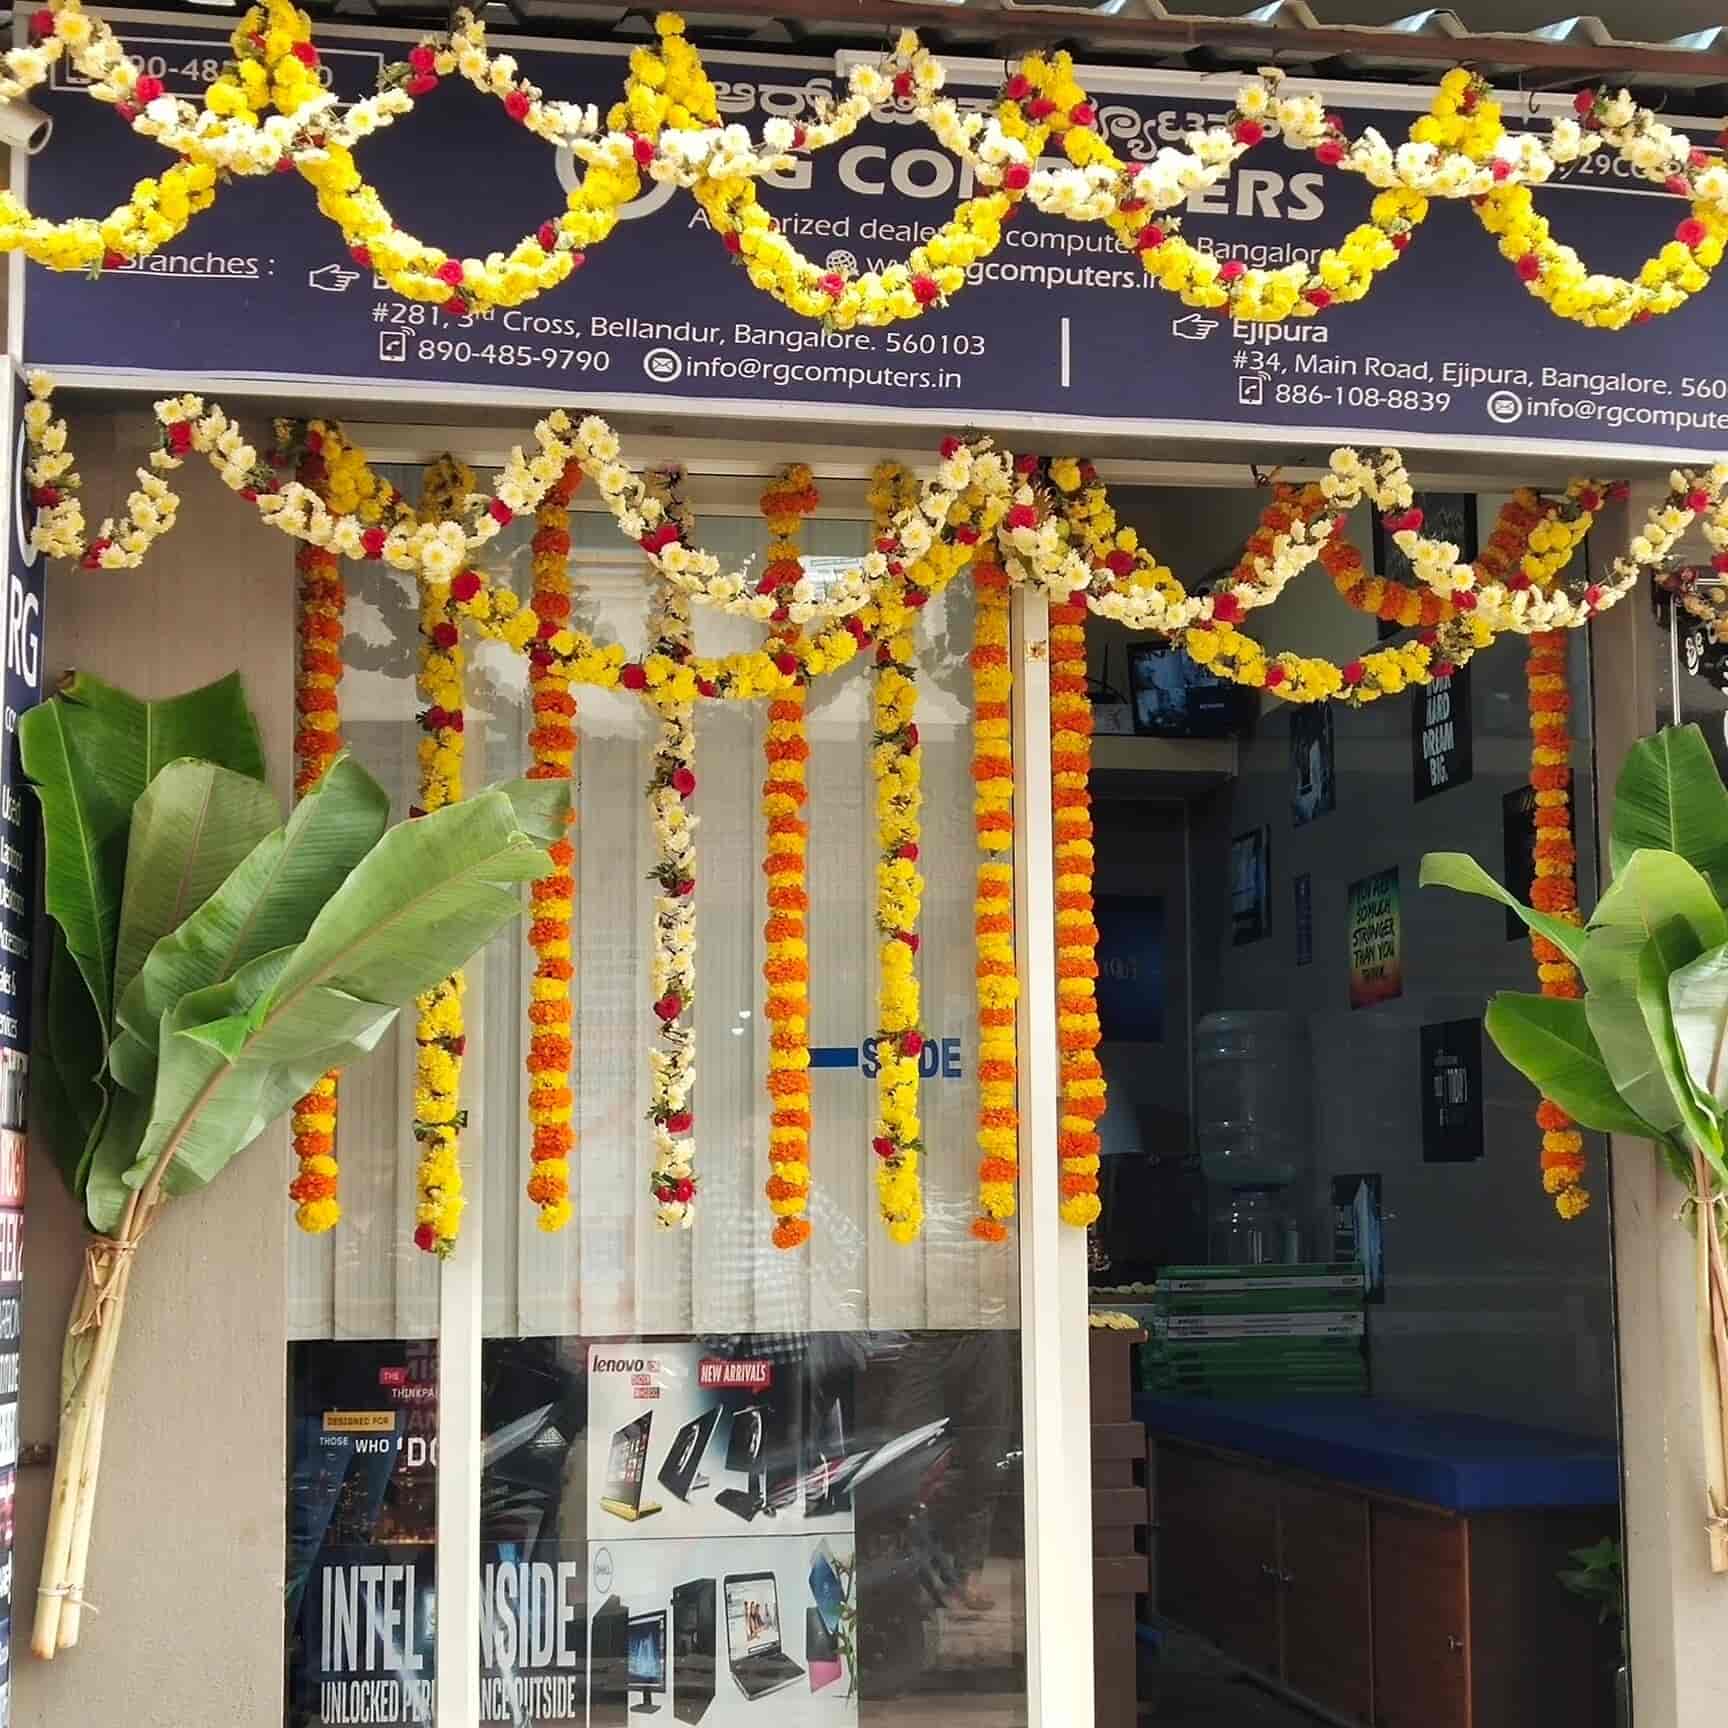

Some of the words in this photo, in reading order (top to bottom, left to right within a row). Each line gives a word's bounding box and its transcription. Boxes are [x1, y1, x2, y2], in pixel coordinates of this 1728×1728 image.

[503, 311, 581, 338] Cross,
[591, 316, 725, 346] Bellandur,
[735, 323, 876, 351] Bangalore.
[886, 332, 986, 356] 560103
[418, 339, 610, 372] 890-485-9790
[686, 355, 962, 389] info@rgcomputers.in
[1233, 349, 1287, 375] #34,
[1295, 353, 1356, 376] Main
[1365, 357, 1434, 383] Road,
[1442, 362, 1533, 388] Ejipura,
[1542, 367, 1672, 396] Bangalore.
[1275, 383, 1451, 412] 886-108-8839
[7, 574, 39, 688] RG
[862, 1037, 962, 1079] SDE
[593, 1355, 644, 1373] lenovo
[701, 1364, 723, 1383] NEW
[391, 1387, 439, 1400] THINKPA
[319, 1436, 349, 1446] THOSE
[355, 1438, 390, 1453] WHO
[321, 1565, 424, 1672] INTEL
[479, 1561, 577, 1669] NSIDE
[320, 1680, 399, 1724] UNLOCKED
